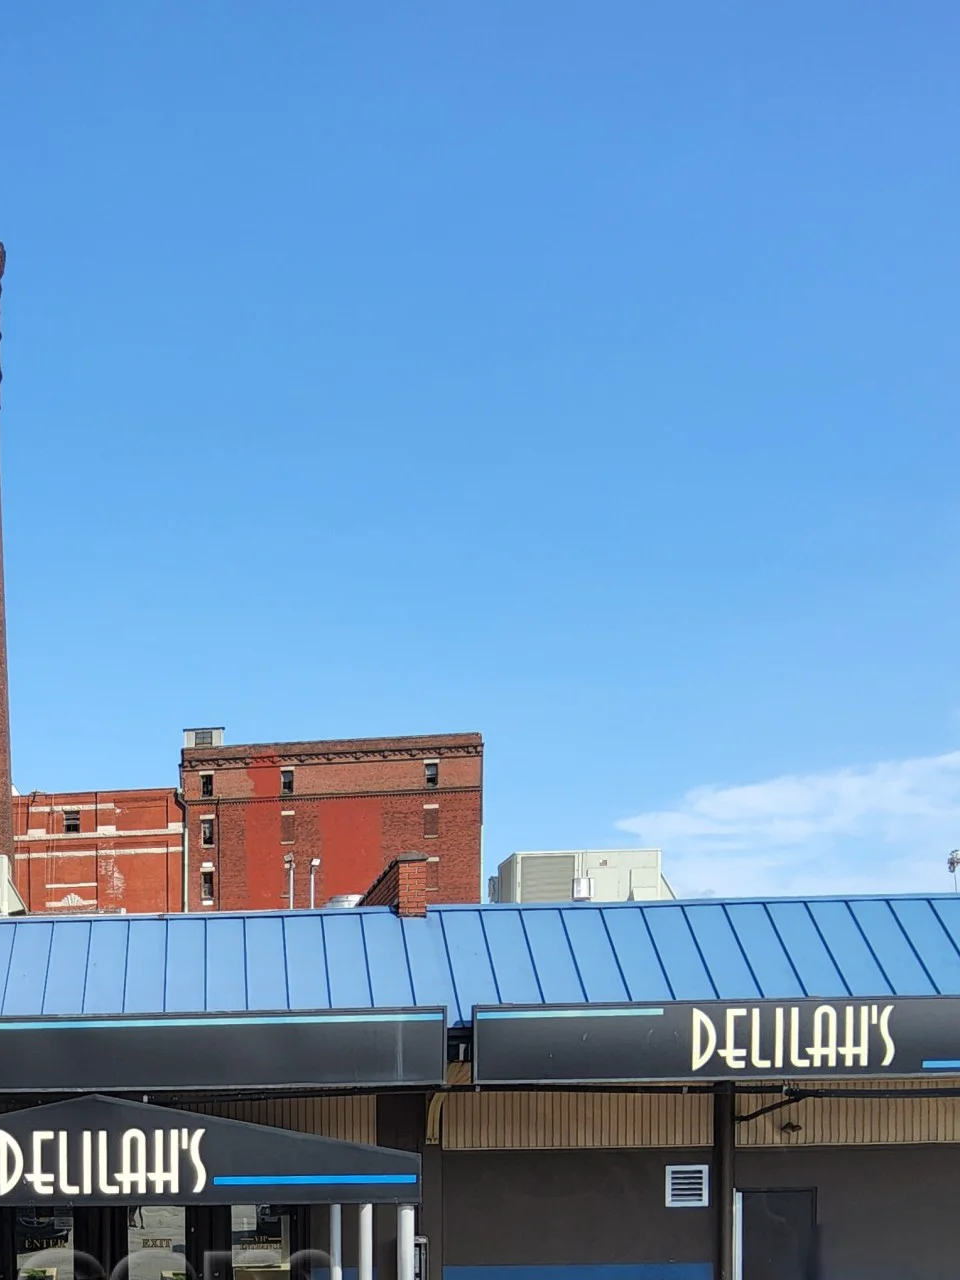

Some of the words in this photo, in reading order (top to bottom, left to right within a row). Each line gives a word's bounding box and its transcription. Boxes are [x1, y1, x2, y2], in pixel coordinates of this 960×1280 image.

[691, 1004, 896, 1072] DELILAH'S
[25, 1238, 66, 1249] ENTER
[142, 1238, 172, 1249] EXIT
